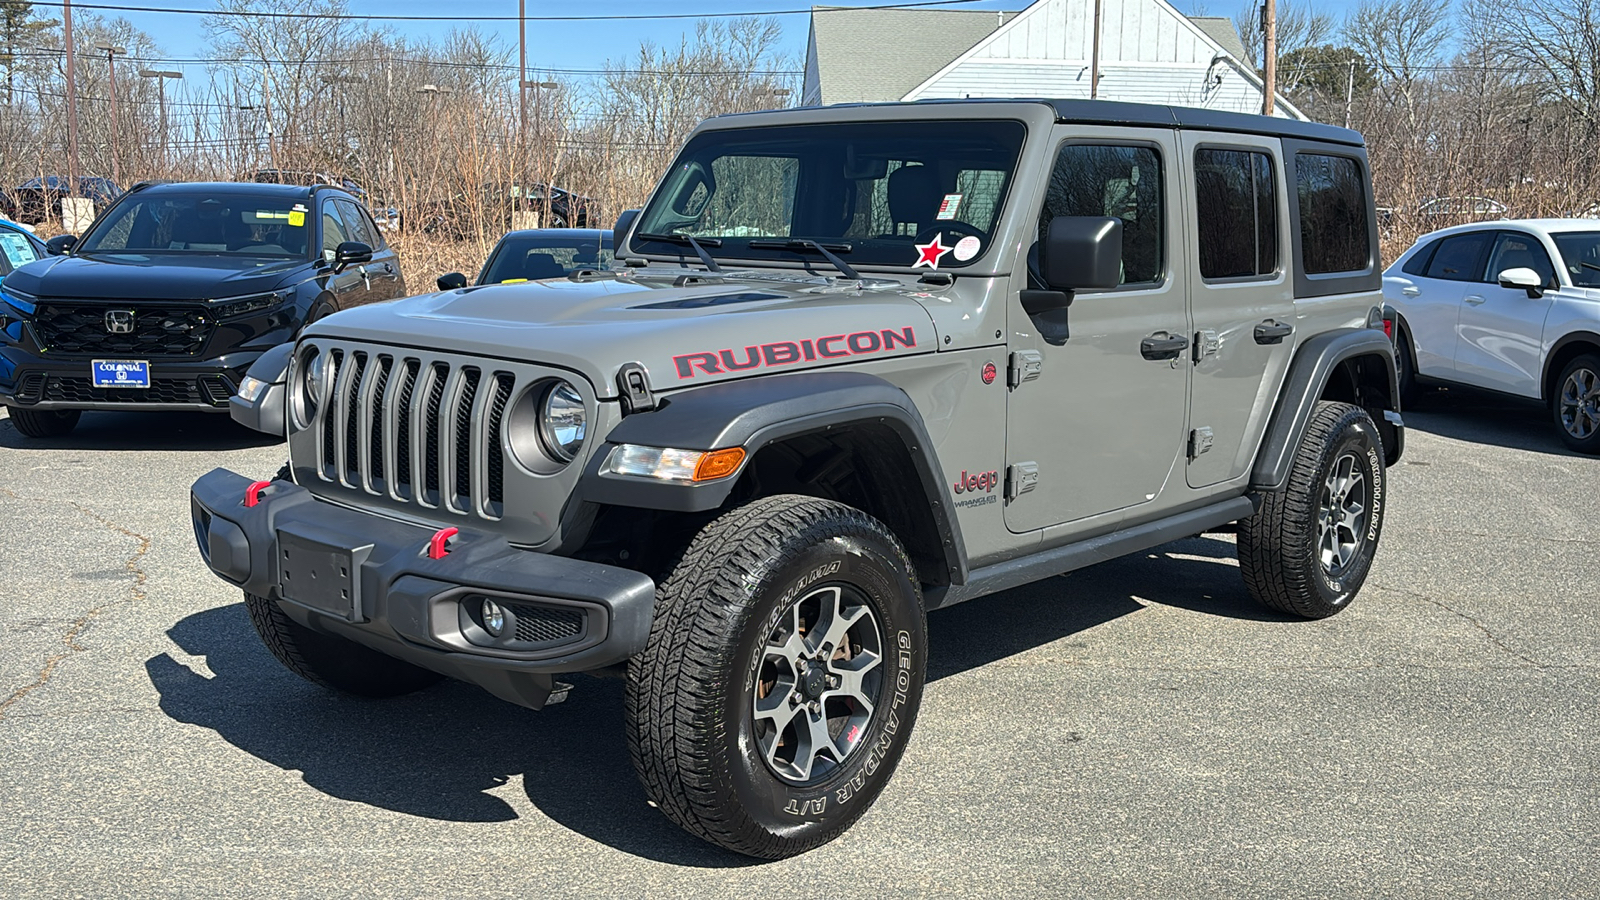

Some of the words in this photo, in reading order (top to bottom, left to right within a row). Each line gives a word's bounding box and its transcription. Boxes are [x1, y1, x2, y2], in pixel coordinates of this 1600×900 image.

[99, 361, 143, 372] COLONIAL
[672, 326, 917, 379] RUBICON
[954, 469, 998, 494] Jeep
[1367, 447, 1382, 541] YOKOHAMA
[954, 495, 997, 508] WRANGLER
[745, 561, 841, 692] YOKOHAMA
[836, 630, 911, 804] GEOLANDAR
[783, 797, 827, 816] A/T
